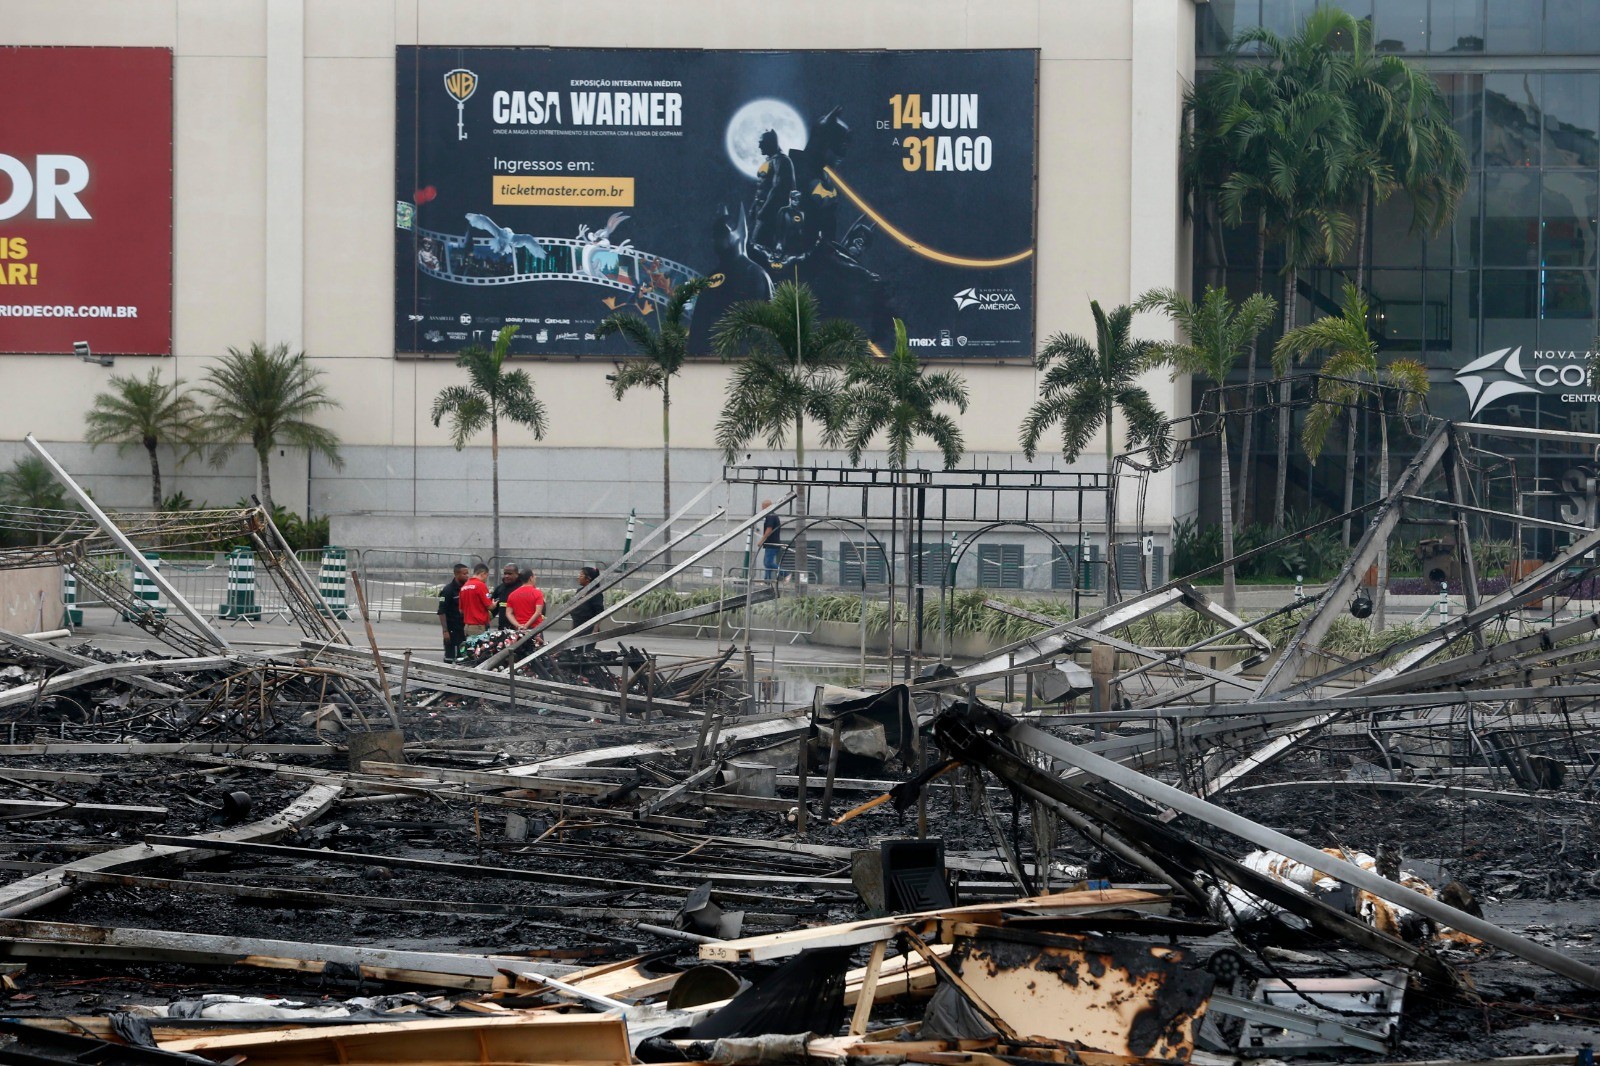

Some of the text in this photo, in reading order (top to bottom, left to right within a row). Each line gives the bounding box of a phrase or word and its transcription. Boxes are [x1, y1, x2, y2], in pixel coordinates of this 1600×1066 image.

[447, 73, 474, 98] WB
[571, 79, 611, 88] EXPOSIÇÃO
[654, 79, 682, 87] INÉDITA
[493, 90, 683, 126] CASA WARNER
[877, 121, 890, 129] DE
[892, 137, 900, 146] A
[494, 157, 595, 173] Ingressos em:
[501, 184, 624, 198] ticketmaster.com.br
[980, 293, 1017, 302] NOVA
[979, 302, 1021, 311] AMÉRICA
[909, 338, 937, 346] max
[1534, 350, 1576, 359] NOVA
[1561, 393, 1600, 403] CENTR
